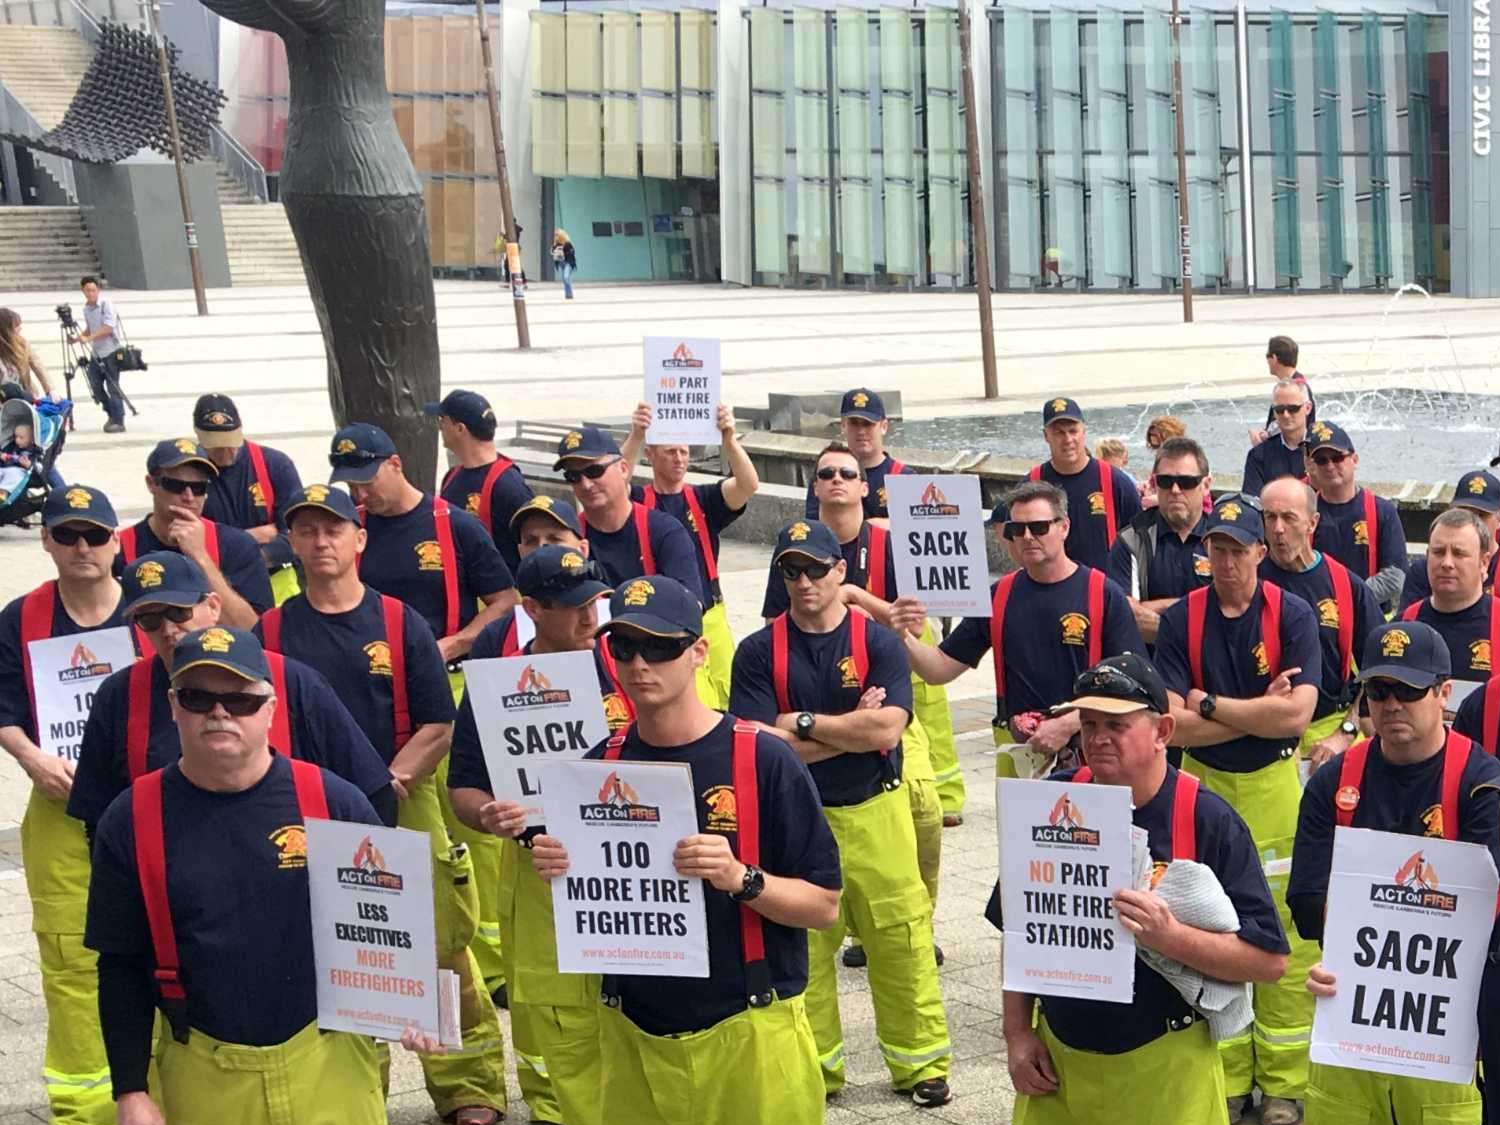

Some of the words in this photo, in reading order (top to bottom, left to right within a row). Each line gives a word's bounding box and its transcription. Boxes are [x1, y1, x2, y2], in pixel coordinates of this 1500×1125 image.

[1473, 85, 1491, 155] CIVIC
[660, 377, 676, 388] NO
[680, 377, 708, 388] PART
[657, 393, 683, 404] TIME
[686, 393, 710, 404] FIRE
[657, 408, 710, 419] STATIONS
[908, 531, 969, 556] SACK
[915, 566, 970, 590] LANE
[61, 669, 79, 681] ACT
[506, 697, 529, 706] ACT
[503, 720, 589, 756] SACK
[517, 768, 542, 796] L
[584, 808, 610, 819] ACT
[613, 810, 628, 818] ON
[629, 808, 657, 821] FIRE
[1036, 829, 1059, 841] ACT
[1060, 832, 1072, 840] ON
[1073, 832, 1098, 844] FIRE
[601, 841, 650, 869] 100
[340, 871, 363, 884] ACT
[1030, 860, 1055, 884] NO
[1061, 863, 1109, 887] PART
[567, 877, 633, 901] MORE
[640, 879, 690, 903] FIRE
[1375, 889, 1405, 902] ACT
[1407, 892, 1421, 903] ON
[1424, 895, 1454, 909] FIRE
[357, 902, 389, 922] LESS
[1024, 891, 1067, 916] TIME
[1073, 894, 1113, 919] FIRE
[576, 910, 687, 936] FIGHTERS
[335, 923, 412, 949] EXECUTIVES
[1026, 922, 1114, 951] STATIONS
[356, 949, 396, 970] MORE
[1354, 926, 1463, 979] SACK
[330, 968, 425, 997] FIREFIGHTERS
[1351, 985, 1450, 1036] LANE
[1338, 1040, 1451, 1064] www.actonfire.com.au
